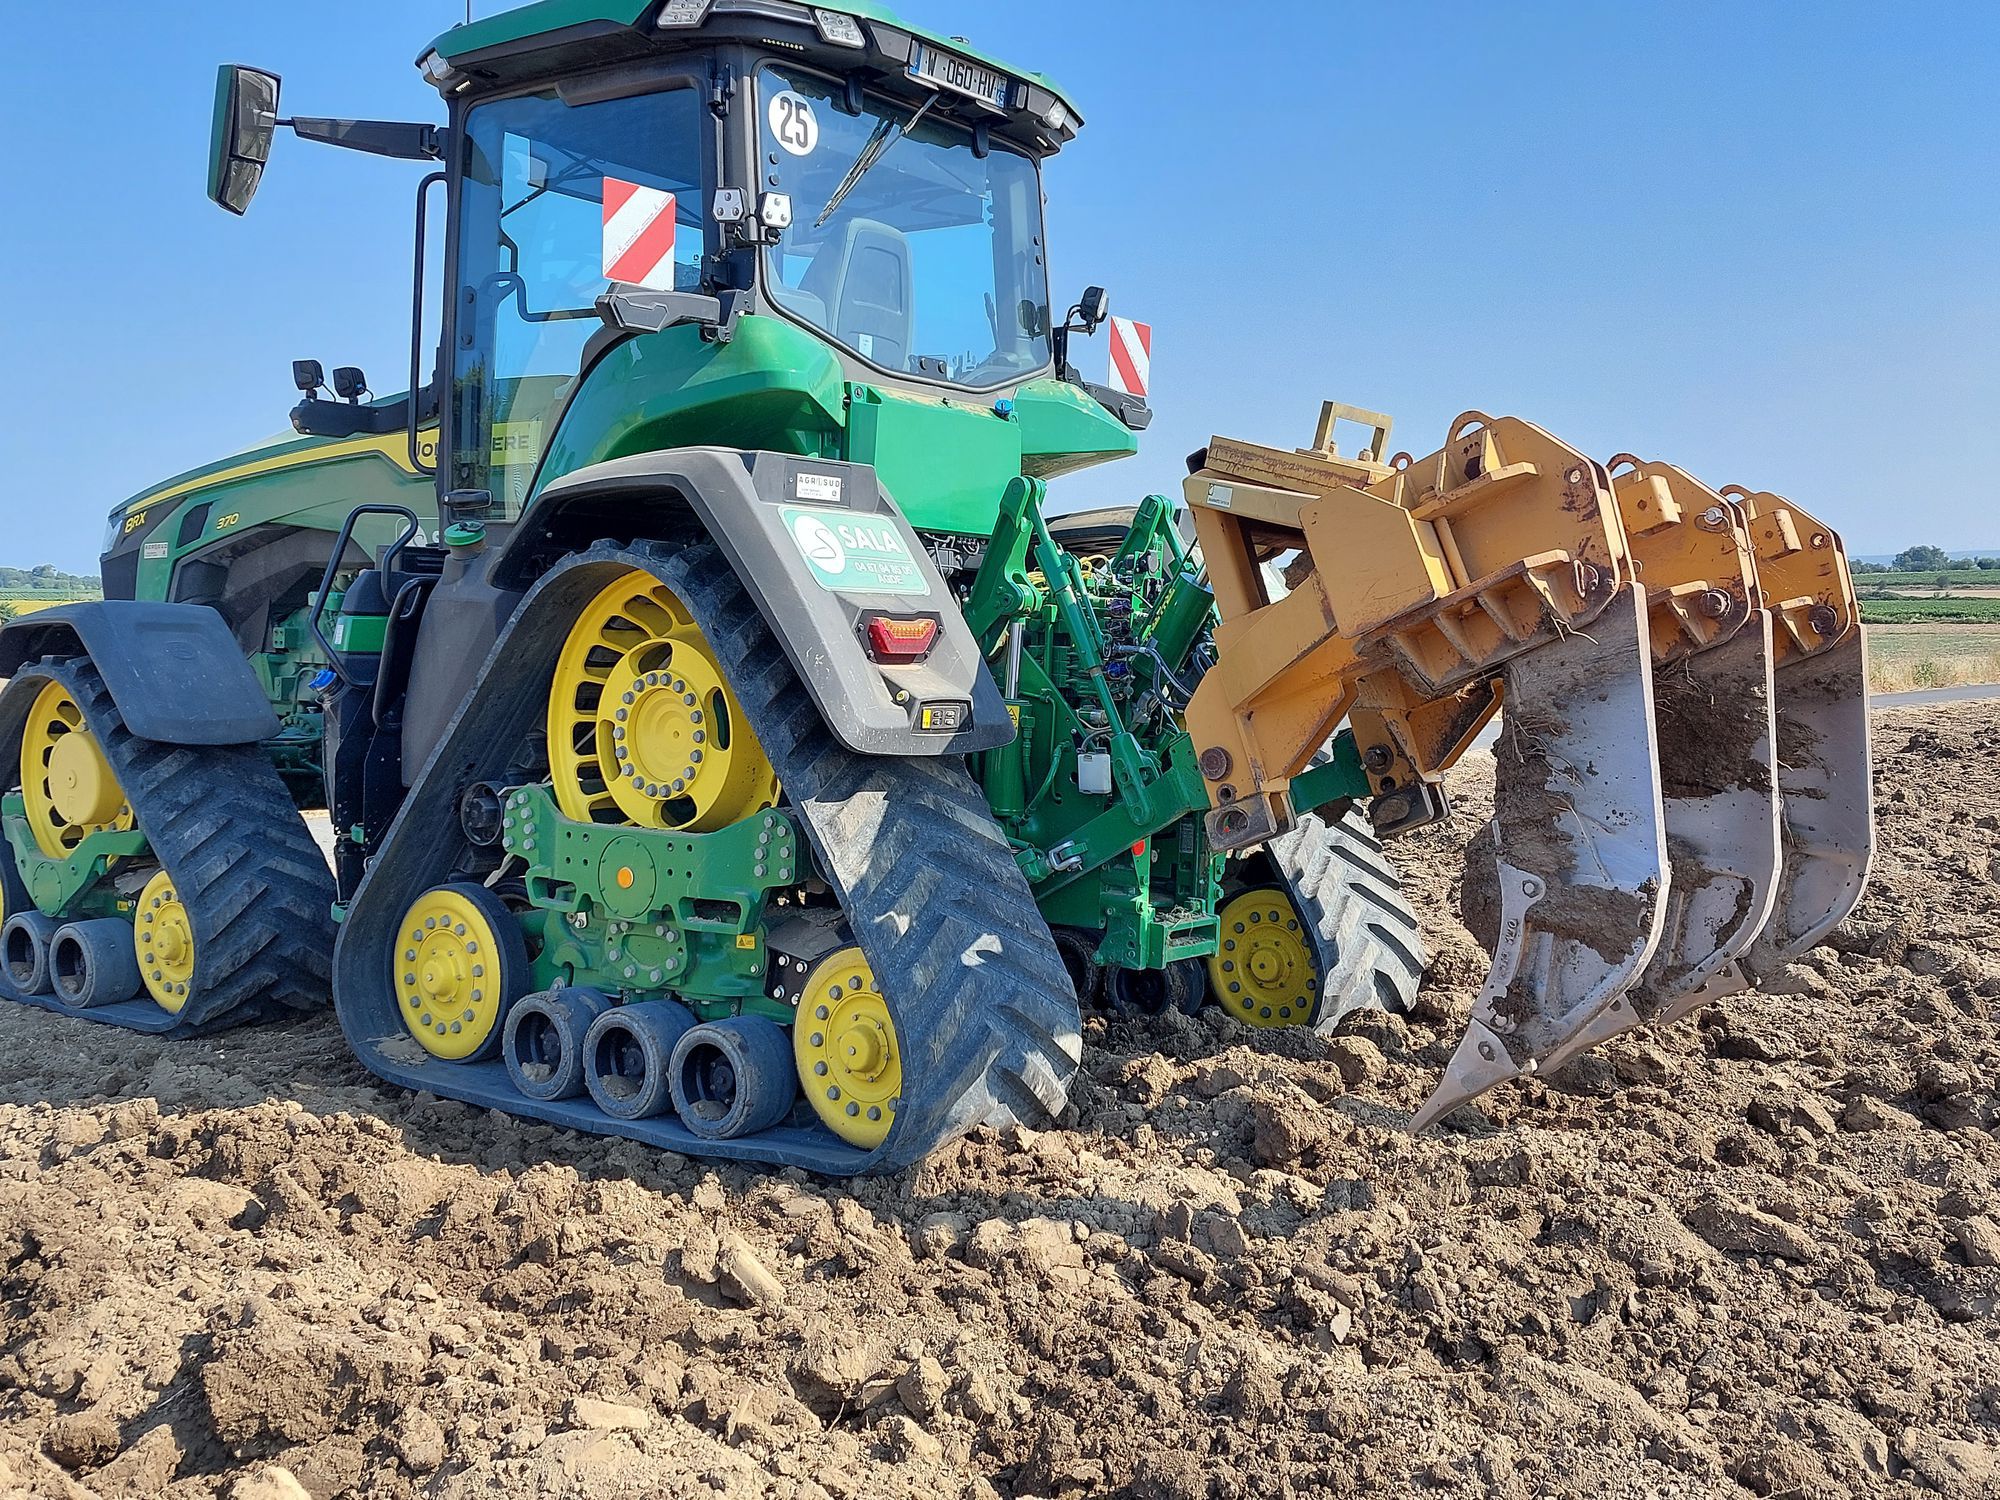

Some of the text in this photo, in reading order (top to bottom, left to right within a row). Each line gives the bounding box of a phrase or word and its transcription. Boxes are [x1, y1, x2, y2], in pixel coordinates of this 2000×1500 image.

[780, 96, 808, 148] 25
[492, 434, 529, 452] ERE
[124, 511, 147, 533] 8RX
[216, 513, 239, 530] 370
[837, 525, 903, 554] SALA
[878, 574, 904, 584] AGDE
